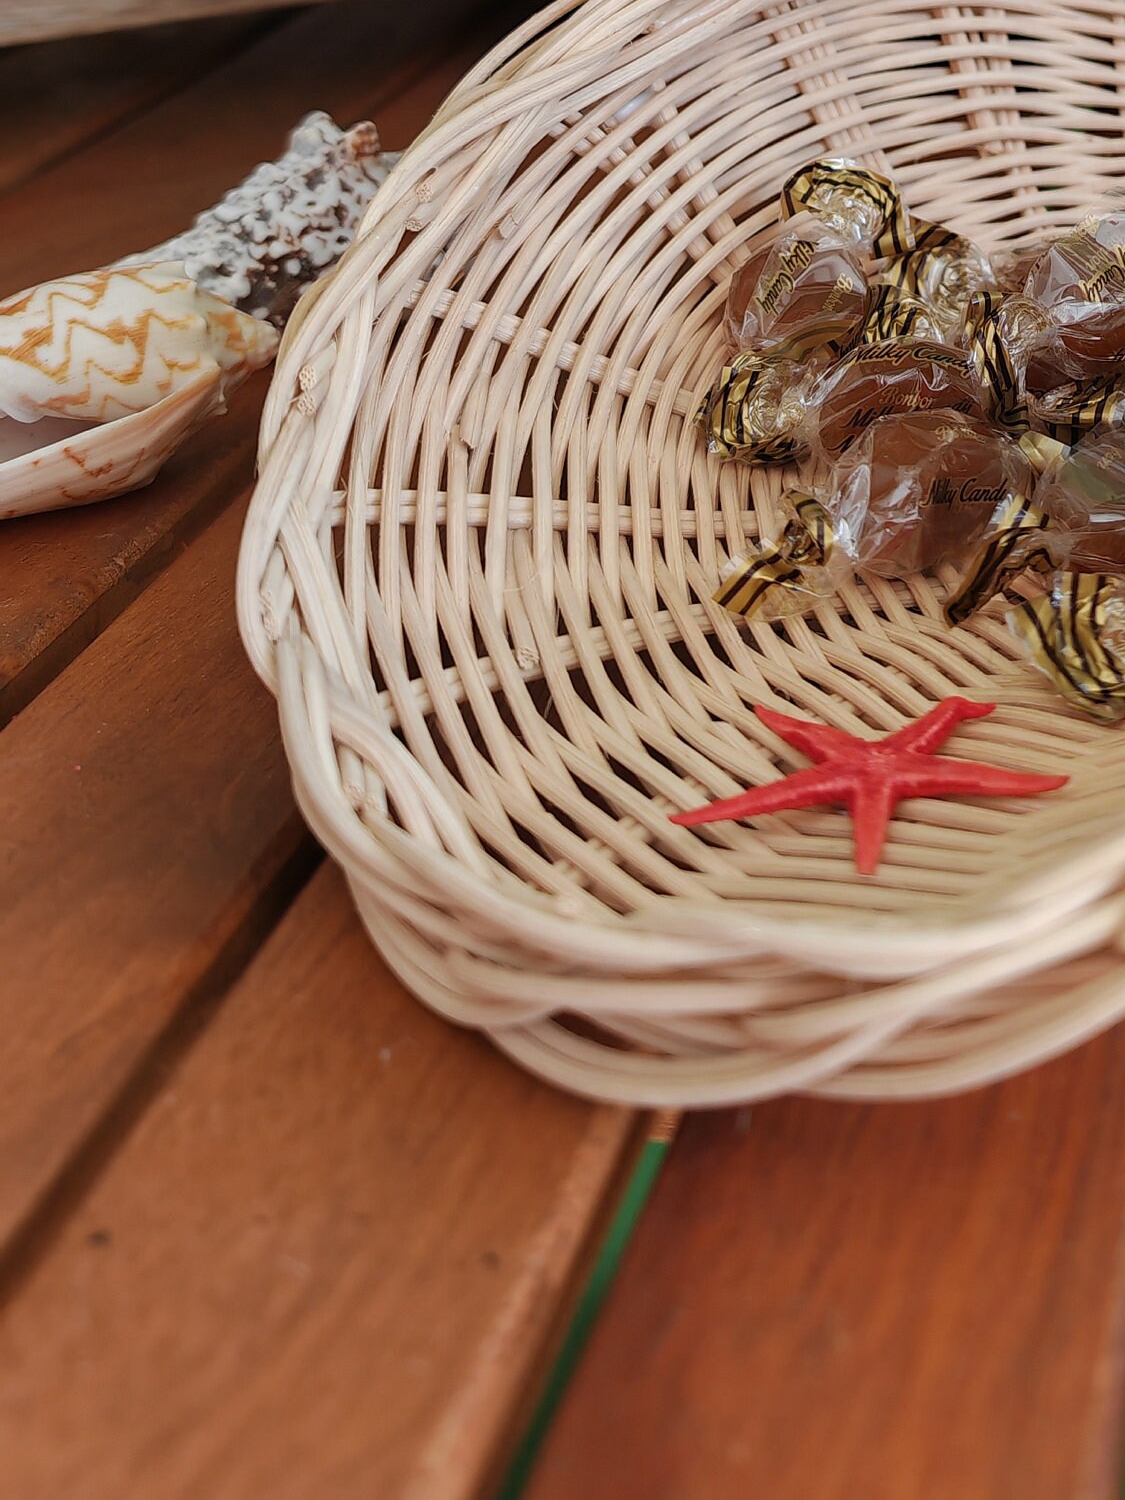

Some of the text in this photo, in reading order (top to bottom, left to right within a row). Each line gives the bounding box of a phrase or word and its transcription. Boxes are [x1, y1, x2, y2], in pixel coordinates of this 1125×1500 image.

[755, 271, 795, 318] Candy
[821, 272, 854, 312] Bonbon
[849, 343, 910, 366] Milky
